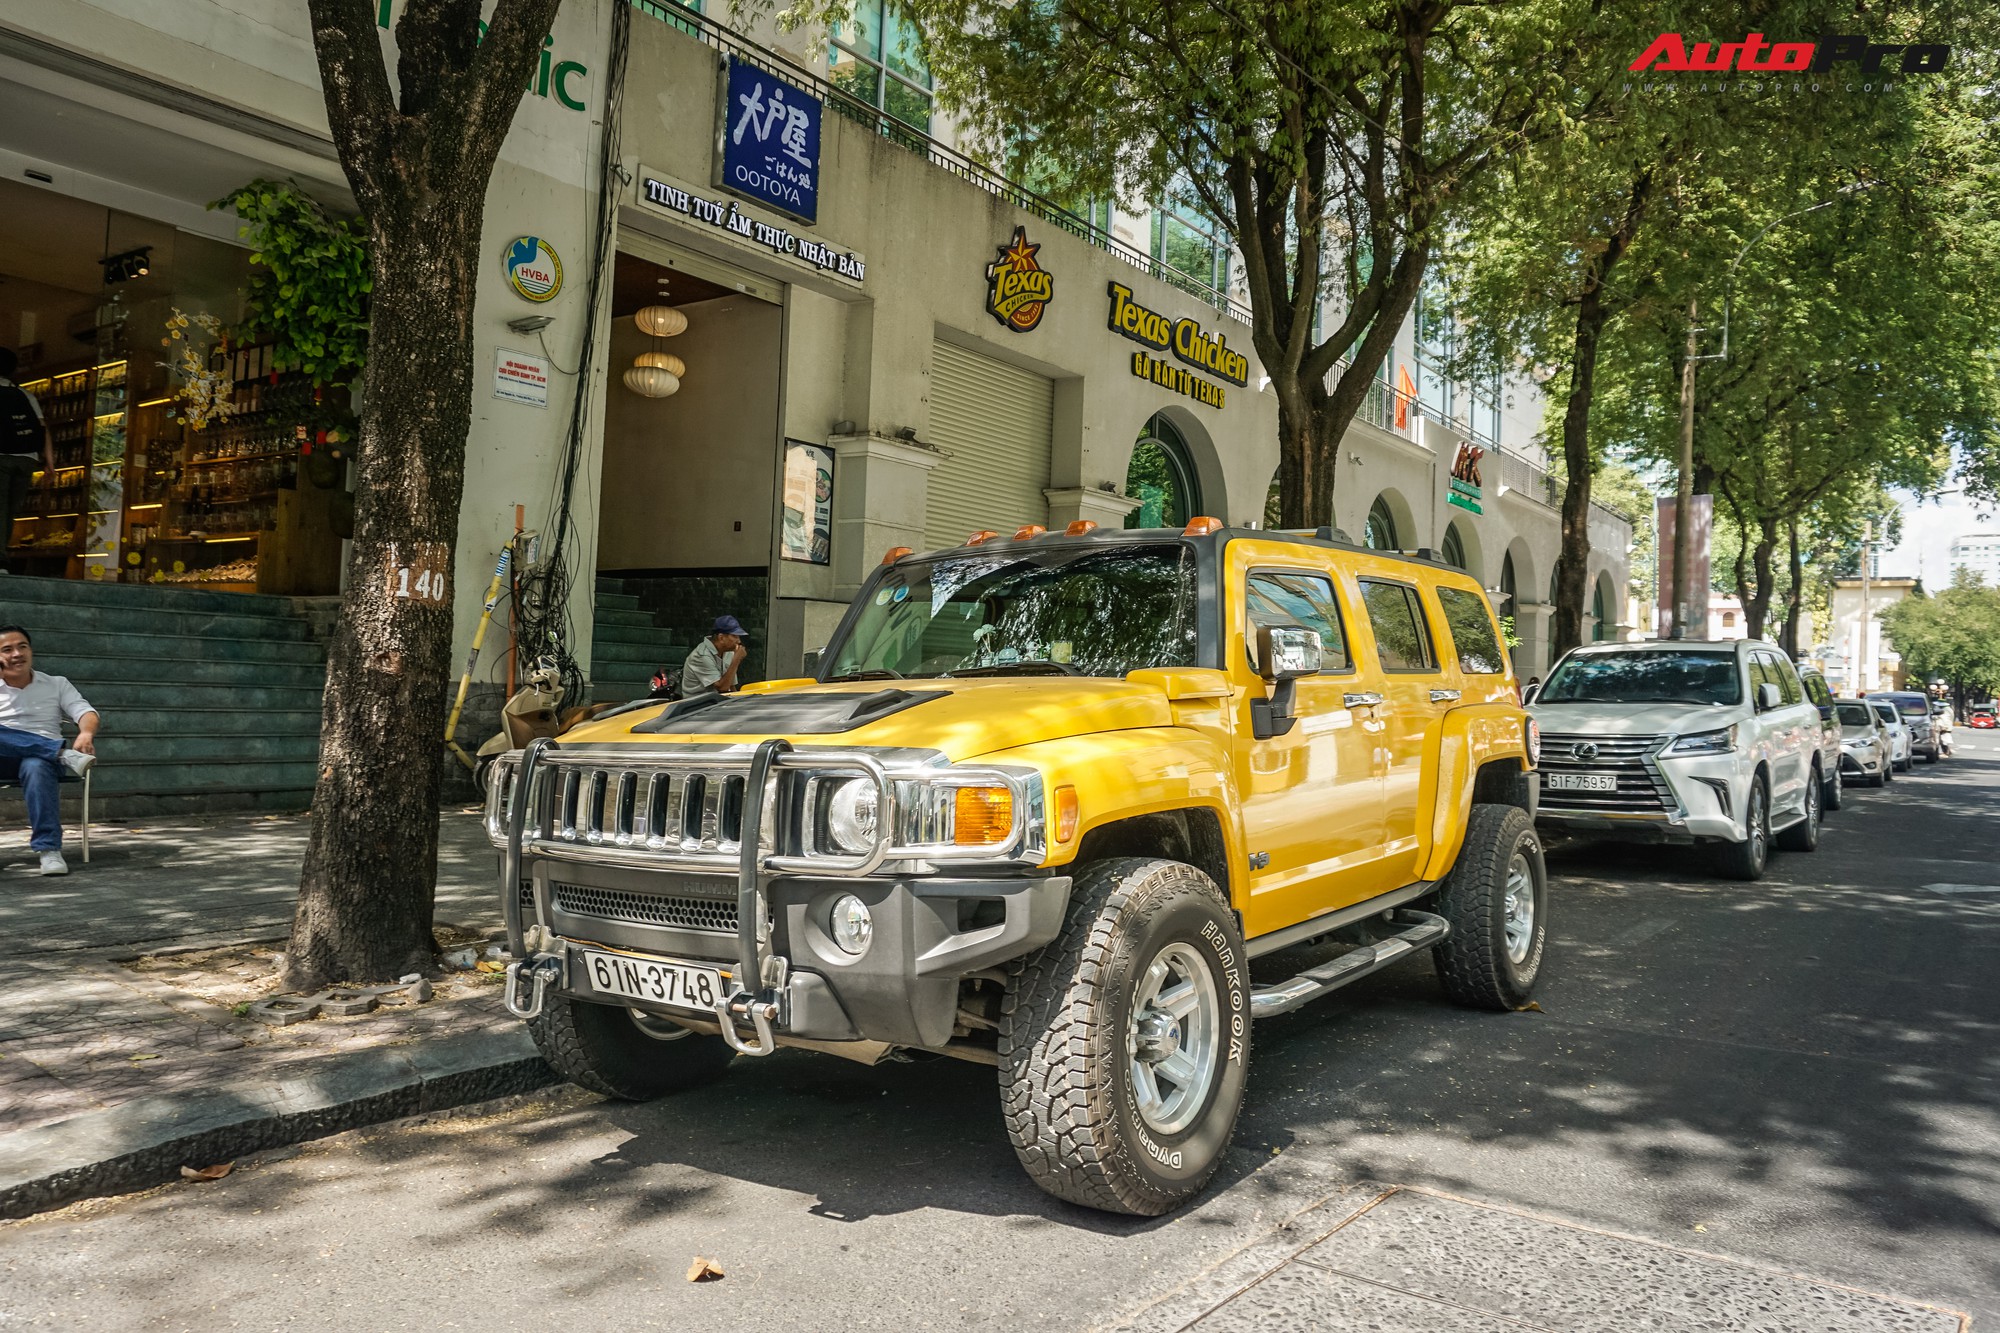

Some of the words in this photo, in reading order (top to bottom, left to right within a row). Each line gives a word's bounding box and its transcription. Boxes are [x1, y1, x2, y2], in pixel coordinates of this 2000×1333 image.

[733, 82, 812, 169] 大戸屋
[735, 165, 801, 206] OOTOYA
[648, 179, 689, 213] TINH
[727, 202, 751, 237] ẨM
[755, 222, 795, 253] THỰC
[799, 239, 836, 269] NHẬT
[838, 253, 865, 281] BẢN
[521, 266, 551, 284] HVBA
[993, 263, 1052, 306] Texas
[1005, 293, 1034, 312] CHICKEN
[1113, 283, 1171, 346] Texas
[1175, 319, 1247, 382] Chicken
[1135, 351, 1150, 379] GÀ
[1154, 360, 1176, 390] RÁN
[1194, 376, 1225, 409] TEXAS
[396, 567, 445, 601] 140
[1551, 775, 1615, 789] 51F-759.57
[684, 881, 739, 896] HUMM
[594, 957, 714, 1007] 61N-3748
